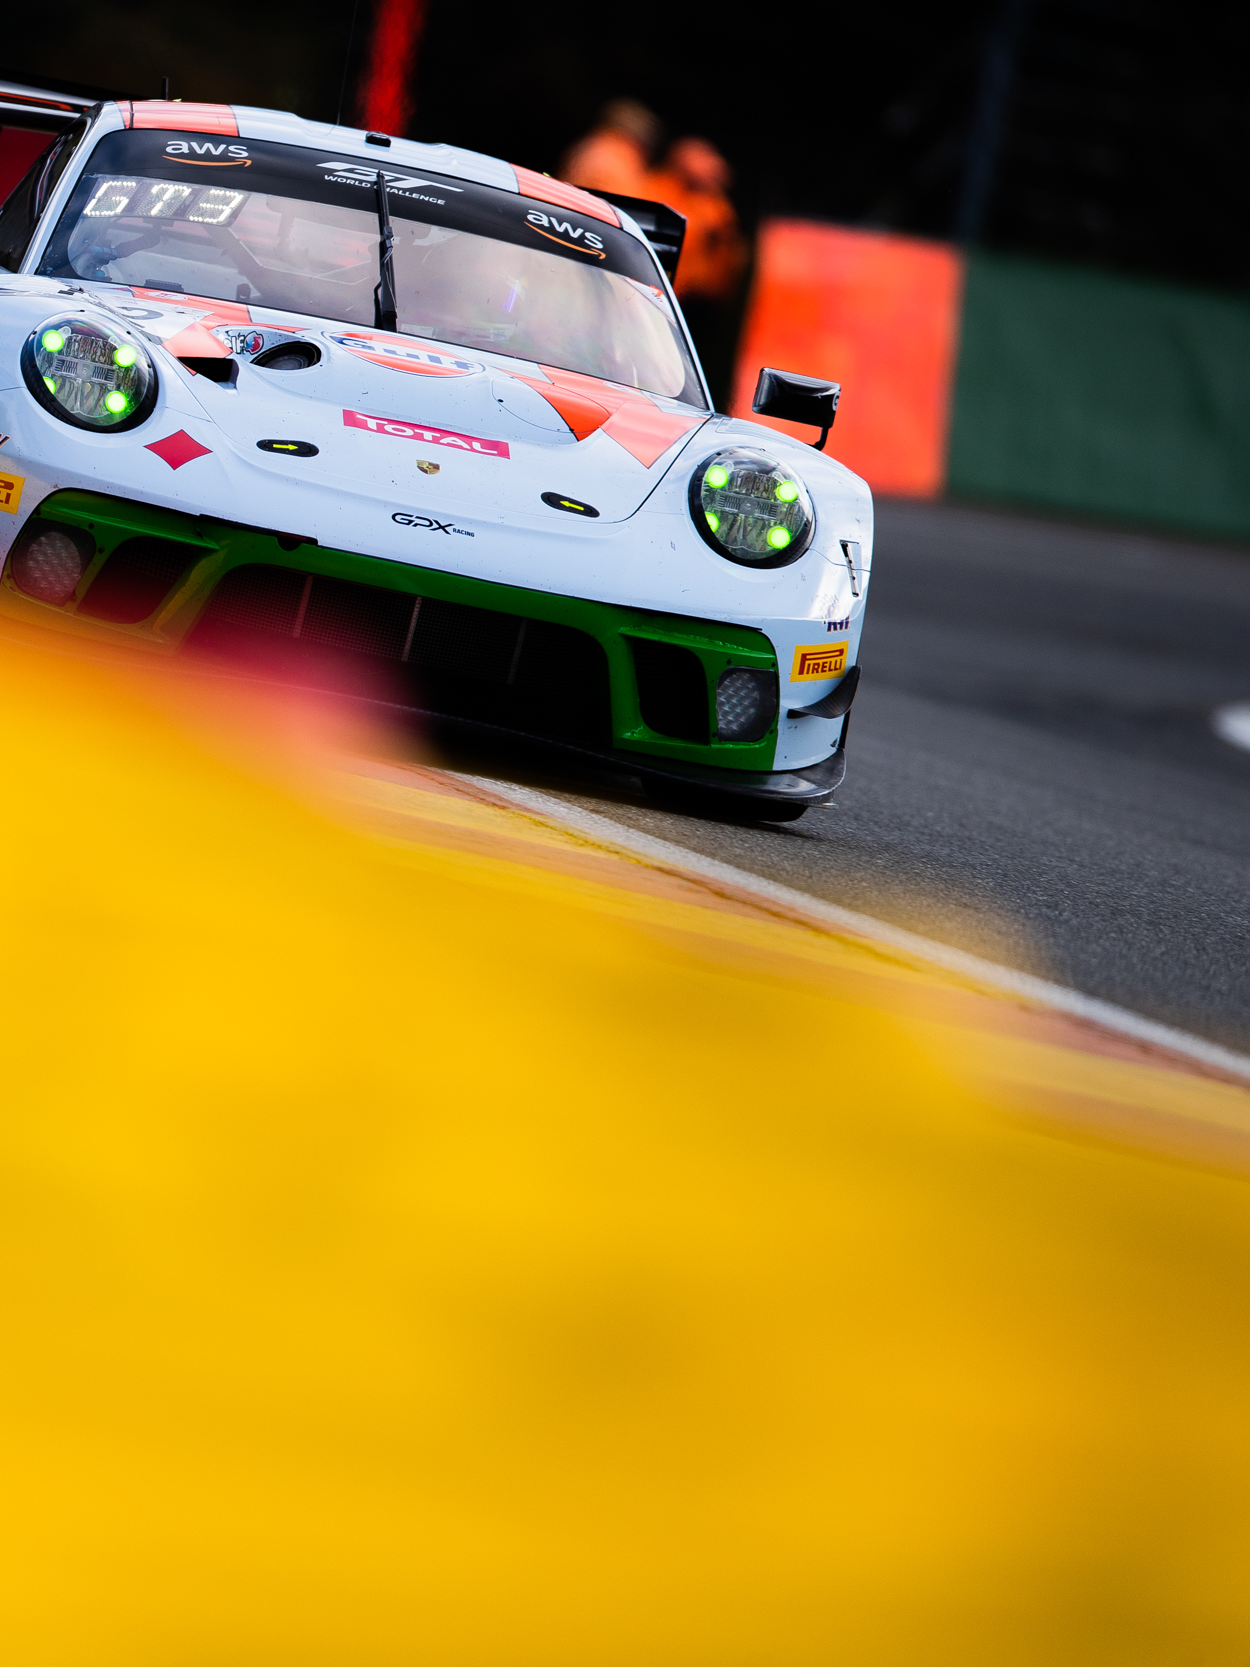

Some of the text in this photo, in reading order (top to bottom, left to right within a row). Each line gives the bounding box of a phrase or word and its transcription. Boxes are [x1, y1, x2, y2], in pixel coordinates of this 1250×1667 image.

[165, 140, 249, 158] aws
[324, 174, 371, 188] WORLD
[83, 180, 244, 223] GT3
[527, 209, 603, 249] aws
[356, 414, 498, 454] TOTAL
[391, 512, 475, 538] GPX RACING
[798, 648, 844, 675] PIRELLI
